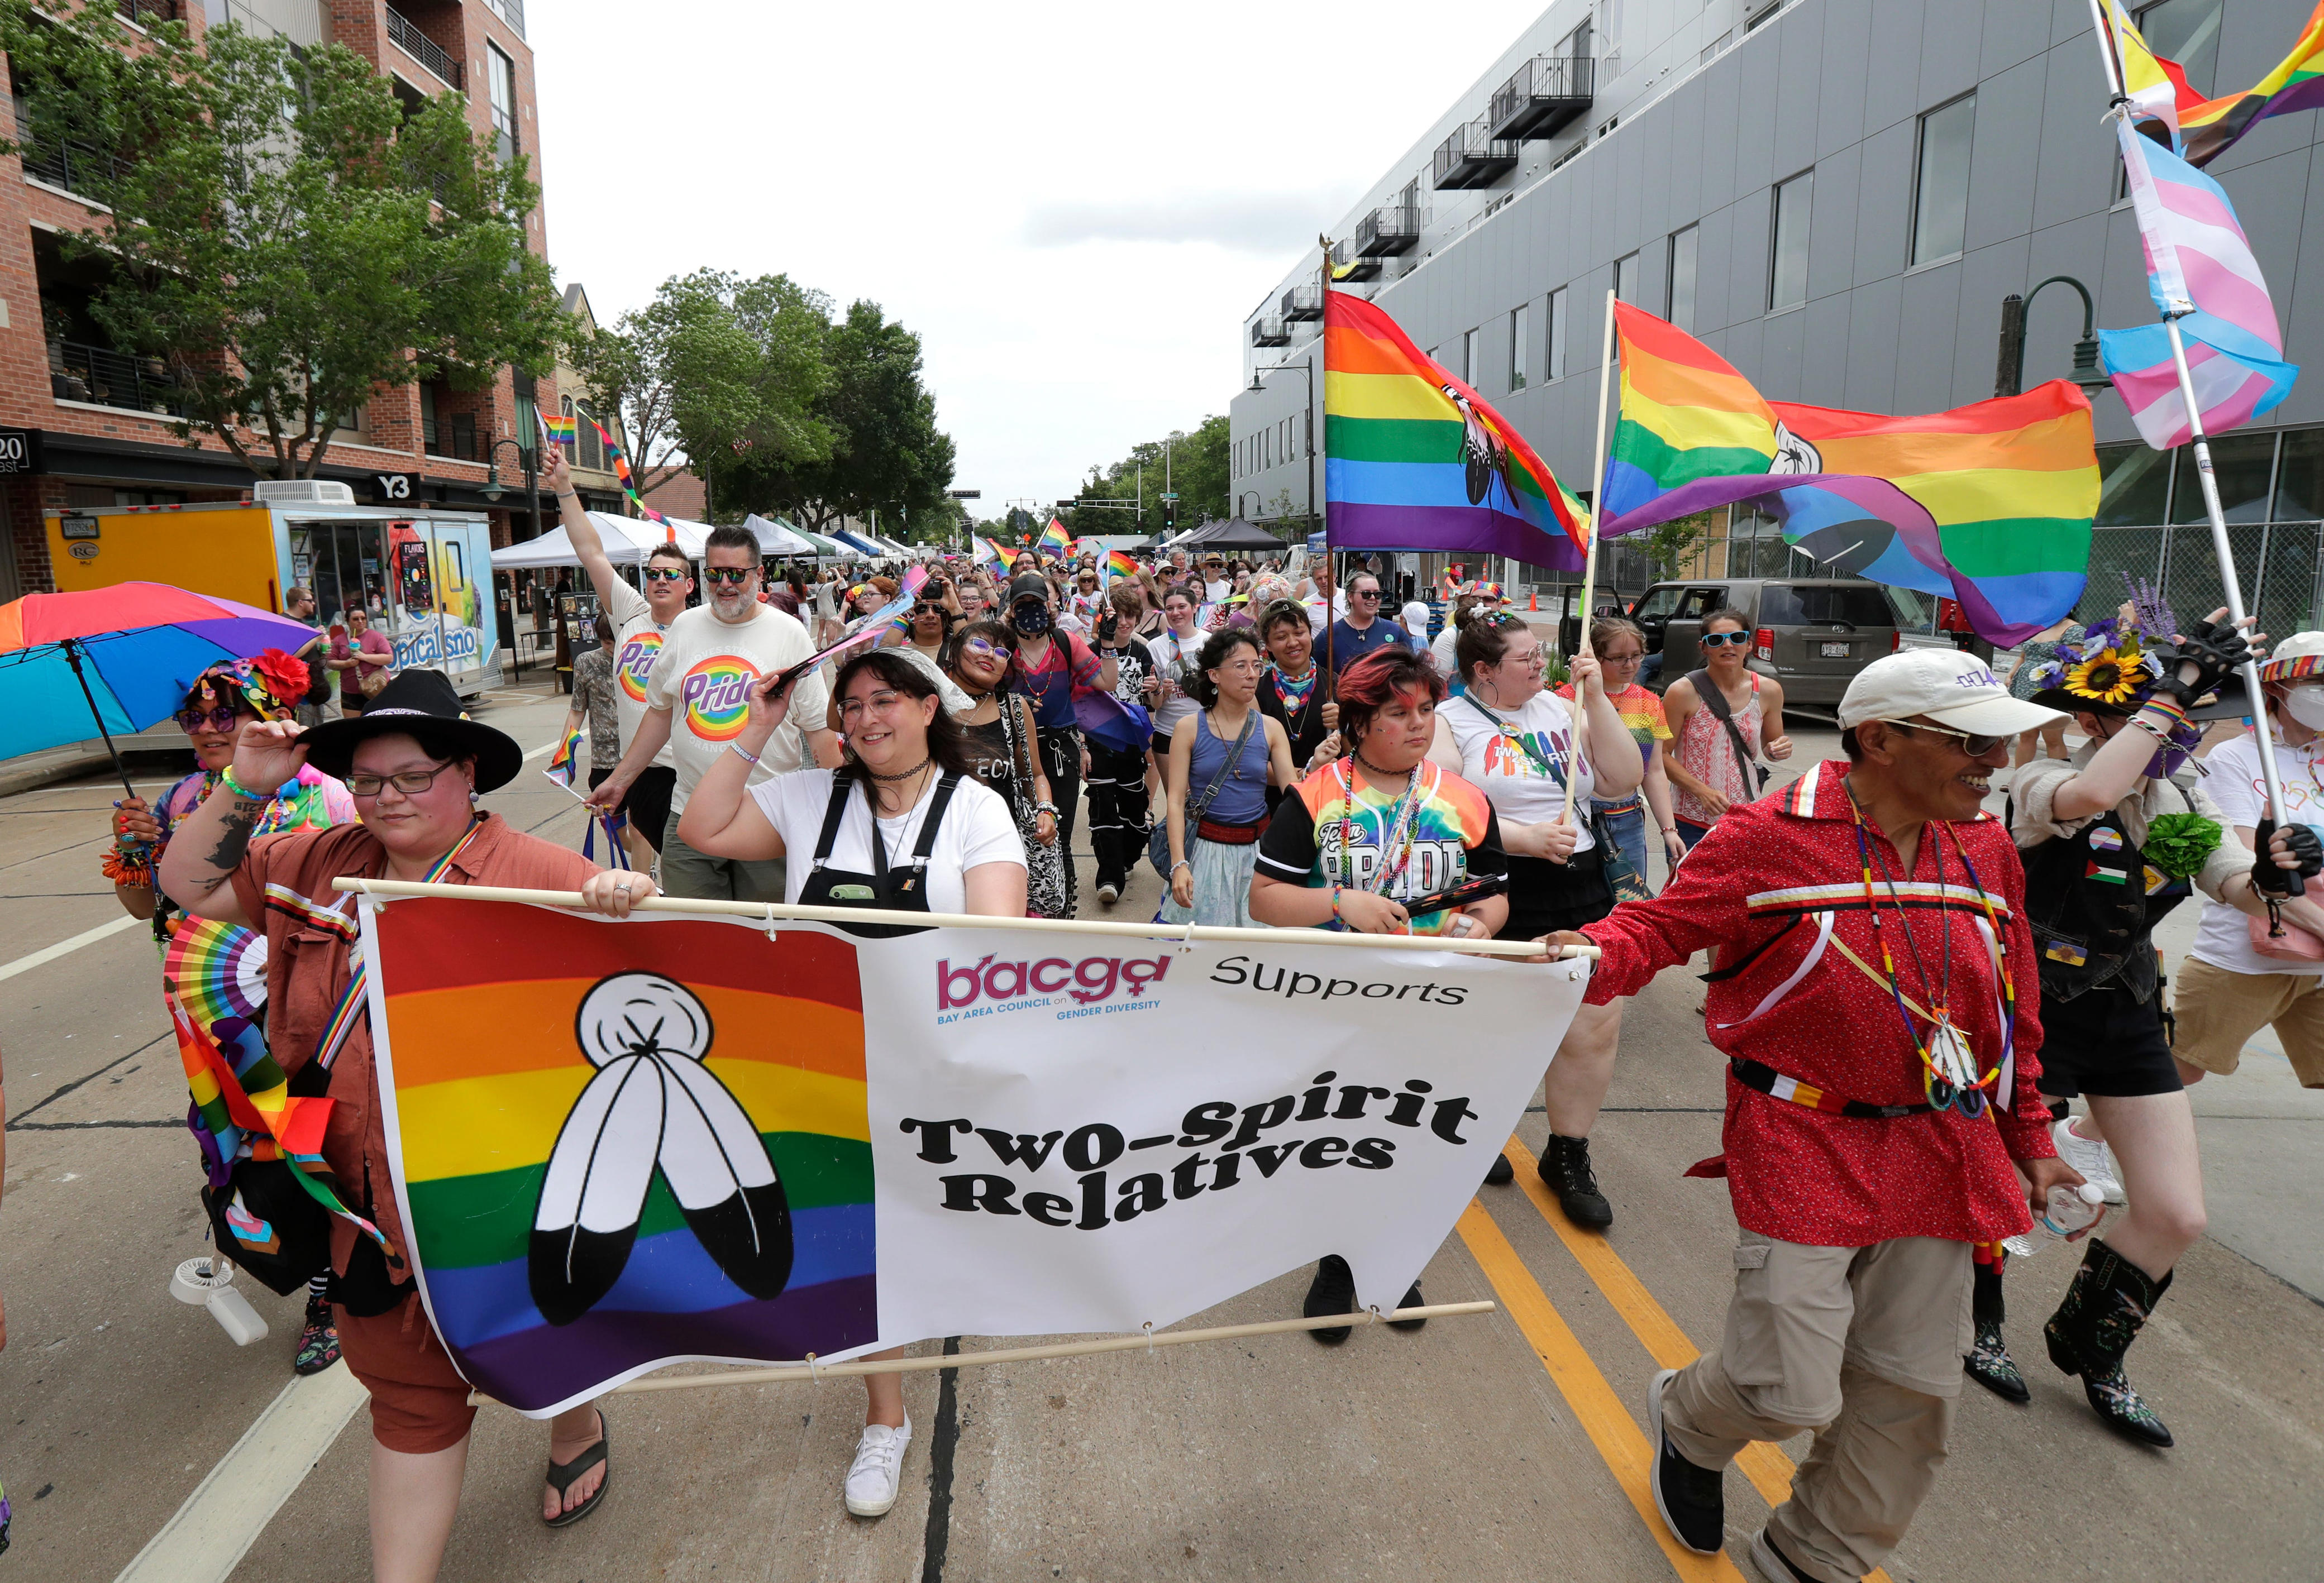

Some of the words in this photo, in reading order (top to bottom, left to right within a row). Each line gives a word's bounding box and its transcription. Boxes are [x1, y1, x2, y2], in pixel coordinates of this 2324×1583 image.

[378, 476, 410, 498] Y3
[445, 629, 476, 659] sno
[615, 643, 660, 676] Pri
[689, 736, 731, 753] ORANG
[936, 952, 1173, 1012] bacgd
[1209, 955, 1469, 1006] Supports
[937, 1013, 959, 1025] BAY
[963, 1007, 994, 1020] AREA
[997, 997, 1052, 1013] COUNCIL
[1054, 996, 1067, 1006] on
[1056, 1006, 1102, 1021] GENDER
[1105, 999, 1161, 1013] DIVERSITY
[938, 1136, 1397, 1231] Relatives
